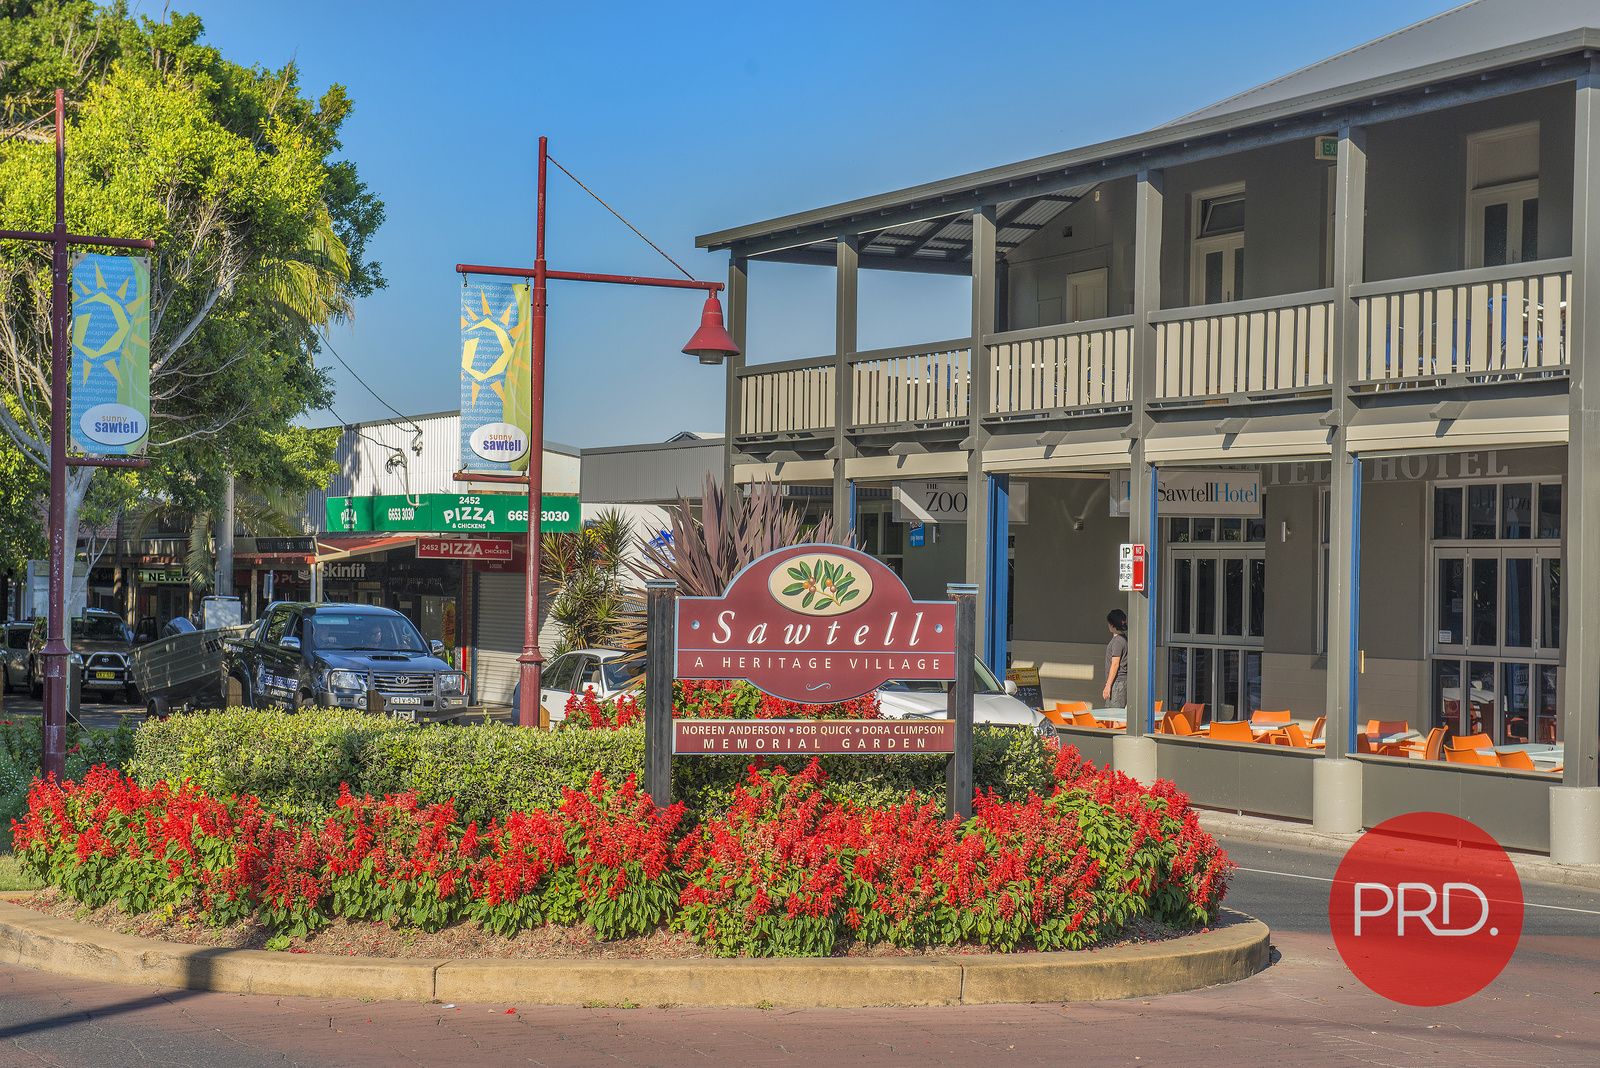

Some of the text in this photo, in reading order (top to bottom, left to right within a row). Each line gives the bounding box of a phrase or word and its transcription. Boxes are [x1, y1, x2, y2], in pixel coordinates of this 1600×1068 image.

[102, 415, 127, 423] sunny
[95, 421, 138, 434] sawtell
[483, 439, 521, 451] sawtell
[1372, 450, 1509, 481] HOTEL
[459, 496, 480, 505] 2452
[926, 491, 967, 512] ZOO
[341, 508, 357, 525] PIZZA
[443, 506, 496, 525] PIZZA
[507, 510, 570, 522] 665 3030
[440, 543, 483, 555] PIZZA
[712, 611, 924, 646] Sawtell
[694, 657, 941, 671] A HERITAGE VILLAGE
[682, 726, 944, 736] NOREEN ANDERSON BOB QUICK DORA CLIMPSON
[703, 738, 926, 750] MEMORIAL GARDEN
